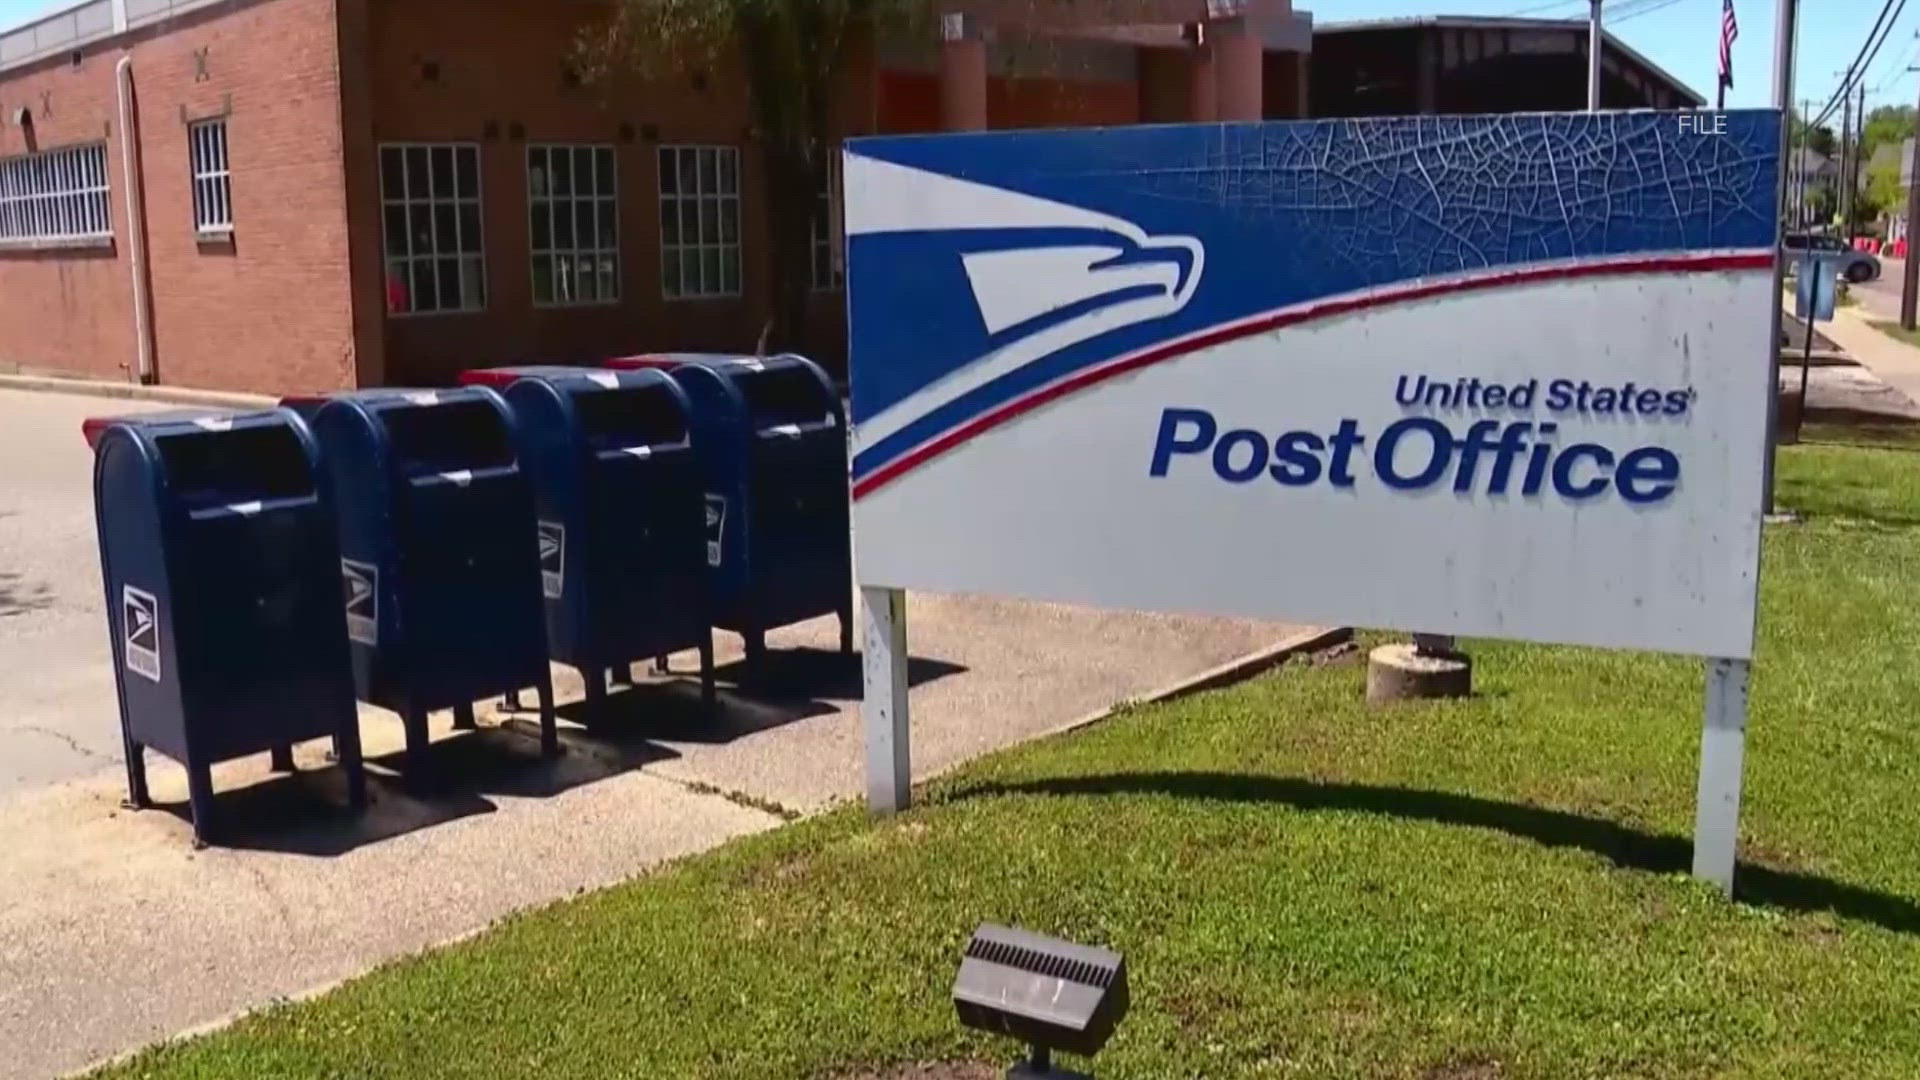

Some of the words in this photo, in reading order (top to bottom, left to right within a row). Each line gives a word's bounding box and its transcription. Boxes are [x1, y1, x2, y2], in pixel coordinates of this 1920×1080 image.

[1396, 375, 1537, 411] United
[1545, 378, 1690, 415] States
[1149, 407, 1365, 488] Post
[1374, 416, 1681, 504] Office
